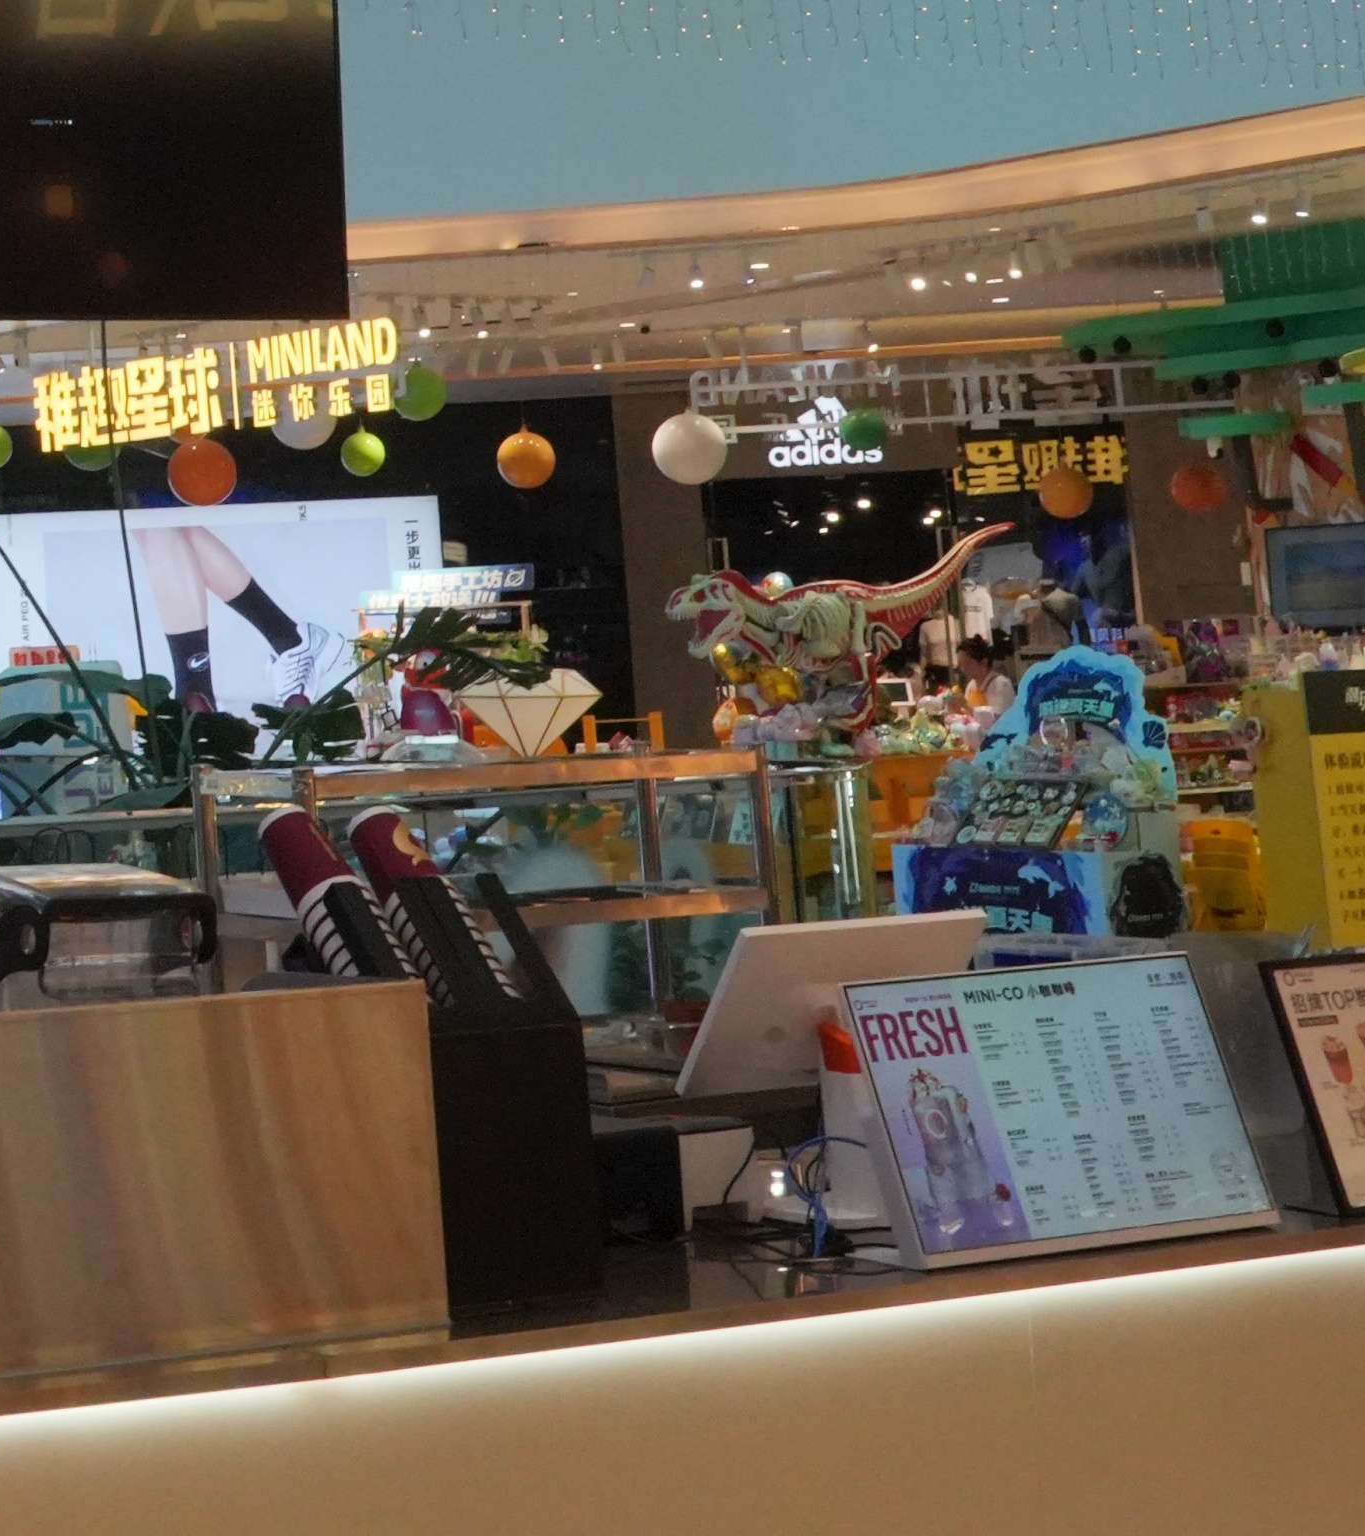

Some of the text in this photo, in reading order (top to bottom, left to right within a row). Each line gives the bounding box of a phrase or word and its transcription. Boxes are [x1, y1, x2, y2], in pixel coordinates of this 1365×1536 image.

[246, 317, 397, 384] MINILAND
[252, 374, 391, 429] 迷你乐园
[21, 600, 30, 641] AIR PEG
[962, 985, 1025, 1006] MINI-CO
[858, 1005, 970, 1064] FRESH
